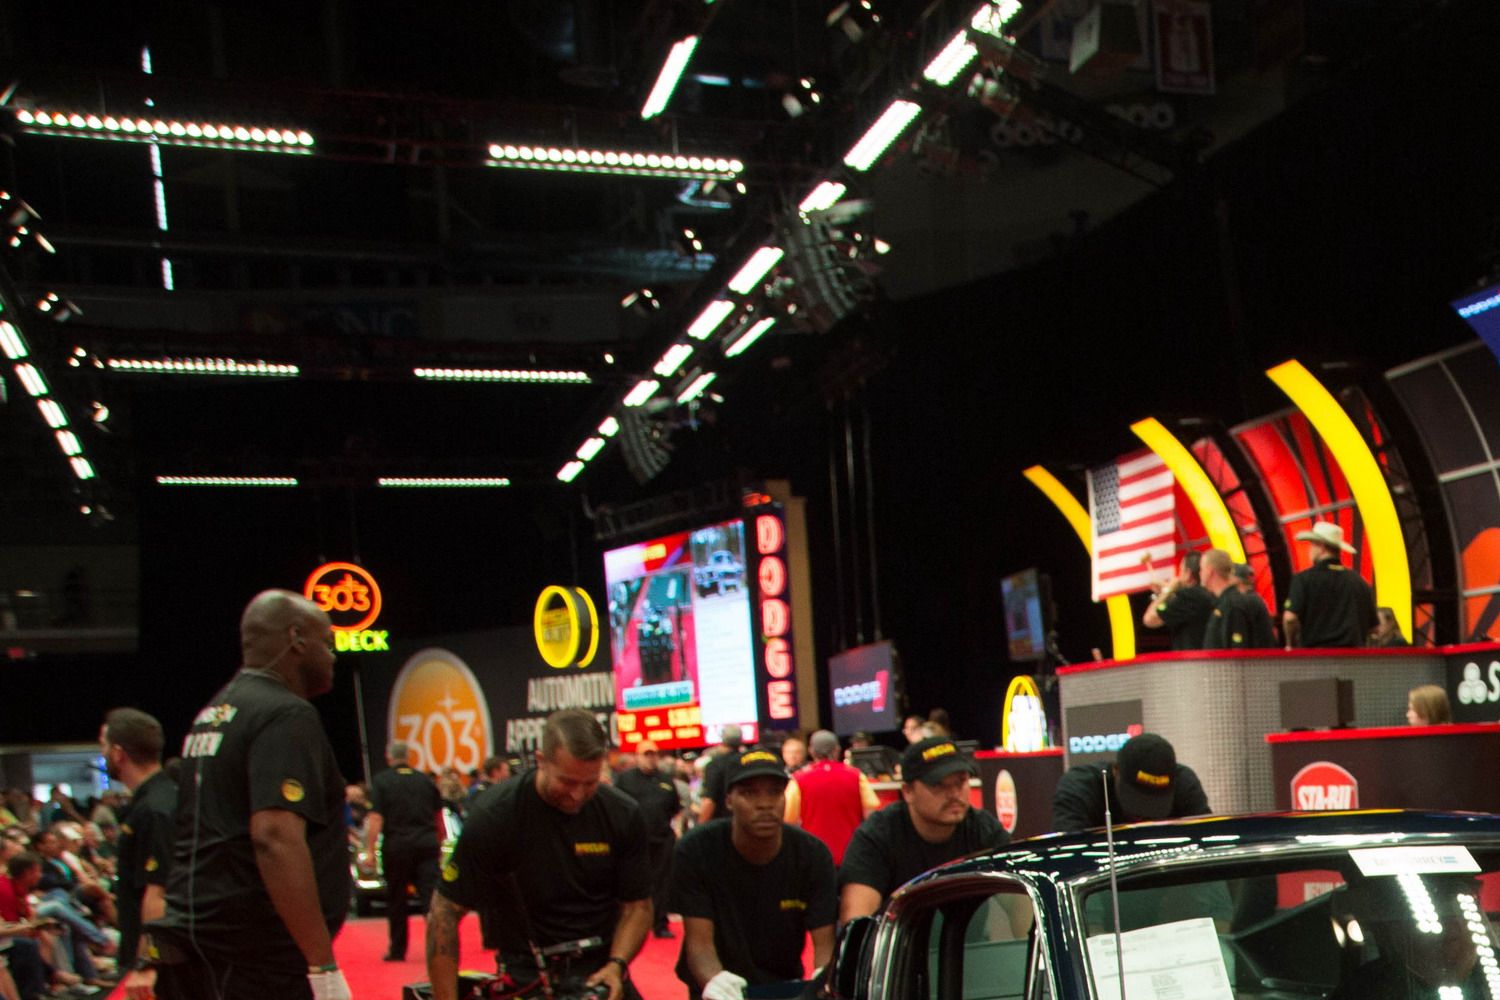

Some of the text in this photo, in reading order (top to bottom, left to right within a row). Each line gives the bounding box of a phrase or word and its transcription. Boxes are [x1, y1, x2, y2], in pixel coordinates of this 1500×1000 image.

[313, 583, 371, 612] 303
[755, 514, 795, 719] DODGE
[335, 630, 390, 652] DECK
